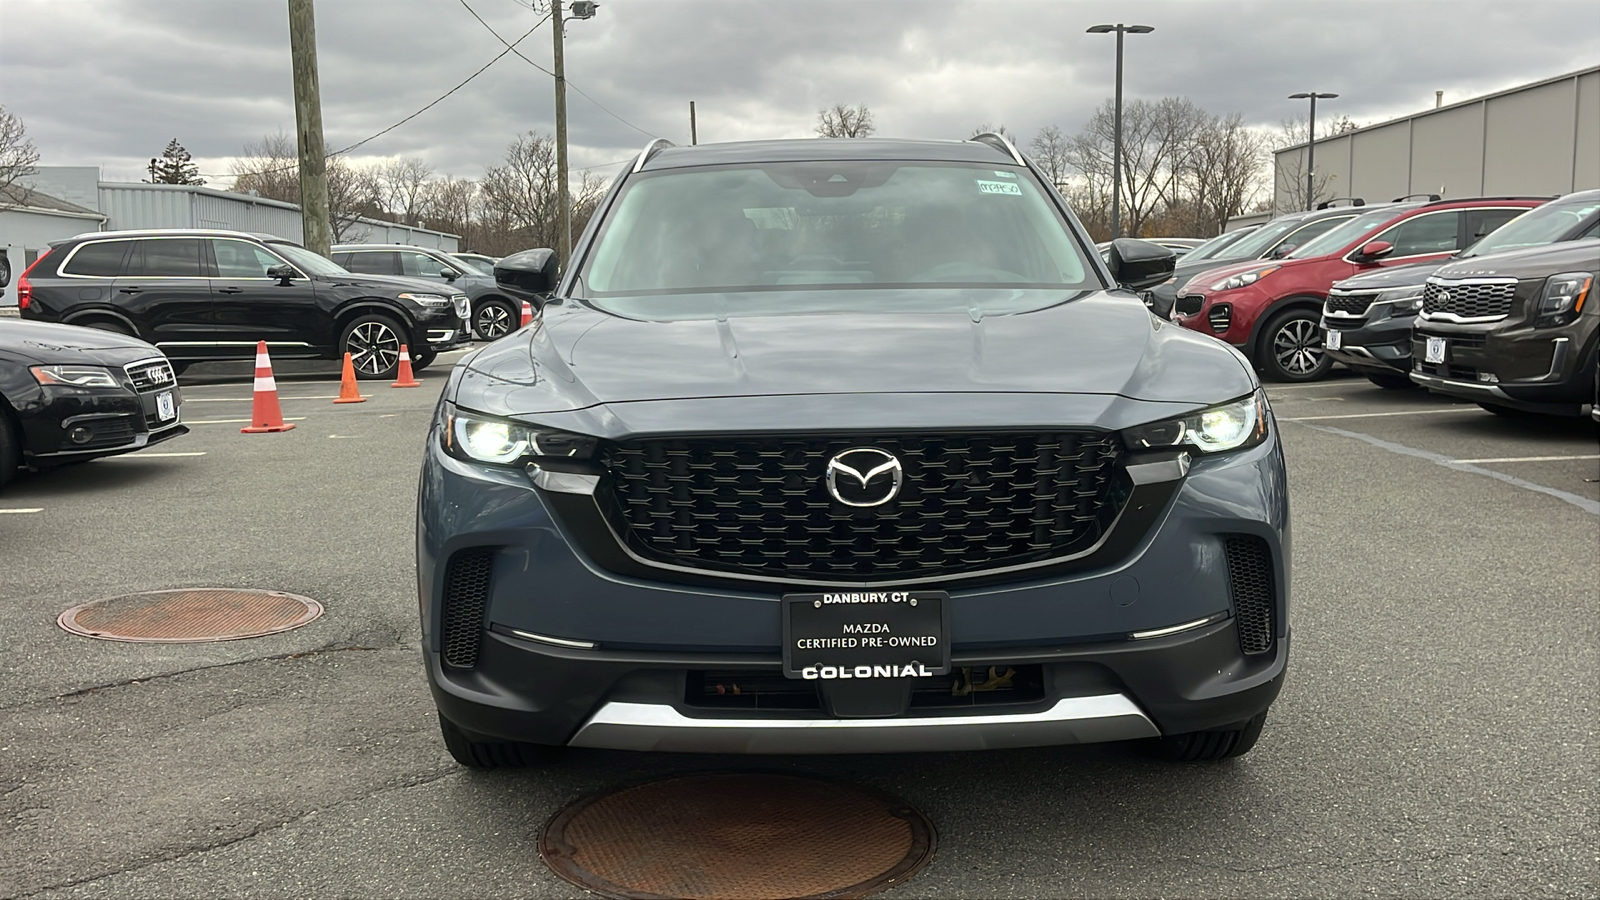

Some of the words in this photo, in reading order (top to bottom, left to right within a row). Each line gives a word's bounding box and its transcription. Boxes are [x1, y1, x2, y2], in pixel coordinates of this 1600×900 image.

[823, 592, 888, 604] DANBURY,
[891, 592, 909, 603] CT
[843, 623, 890, 634] MAZDA
[797, 638, 858, 649] CERTIFIED
[861, 636, 937, 647] PRE-OWNED
[802, 665, 933, 680] COLONIAL
